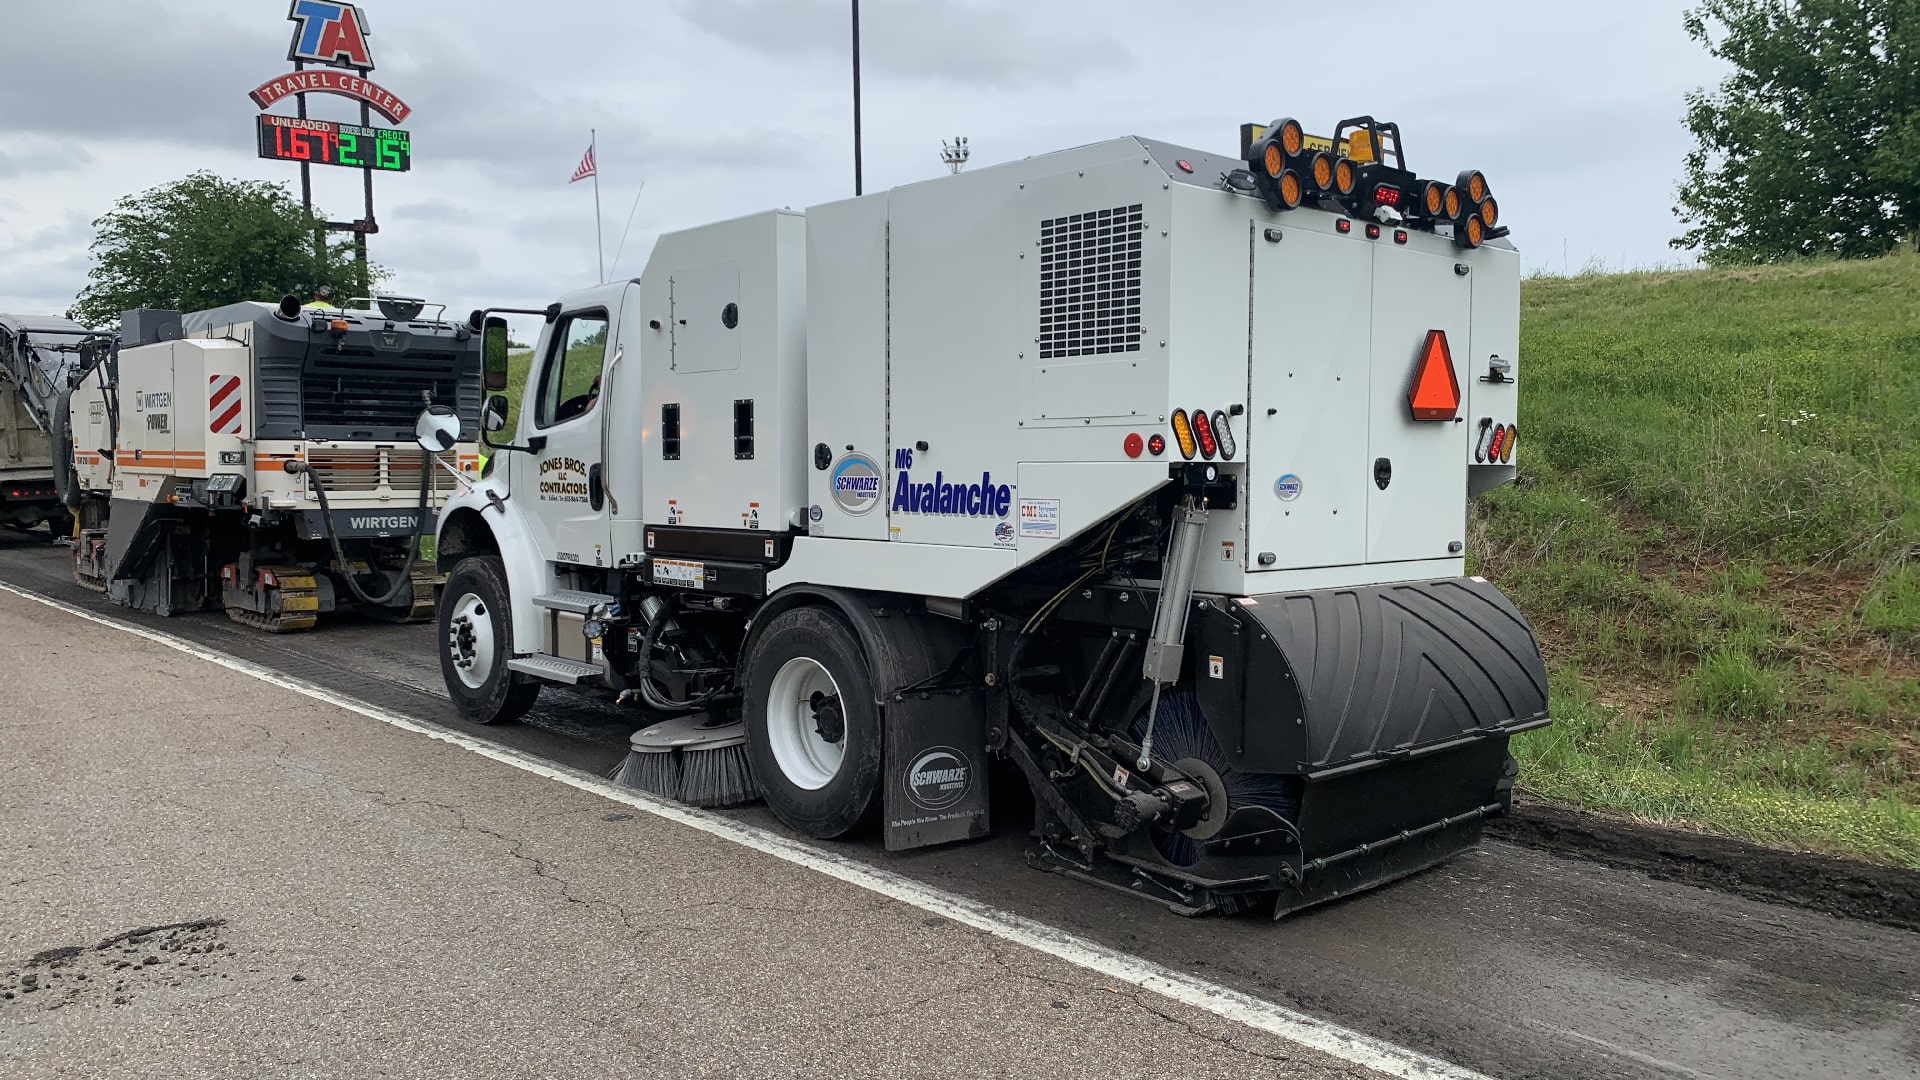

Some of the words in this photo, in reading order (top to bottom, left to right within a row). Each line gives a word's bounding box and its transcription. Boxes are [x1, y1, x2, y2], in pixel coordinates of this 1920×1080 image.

[295, 1, 369, 63] TA
[262, 73, 331, 100] TRAVEL
[339, 76, 404, 117] CENTER
[271, 116, 331, 132] UNLEADED
[377, 130, 408, 141] CREDIT
[145, 391, 172, 408] WIRTGEN
[540, 457, 562, 476] JONES
[895, 448, 913, 469] M6
[558, 472, 567, 480] LLC
[837, 477, 878, 491] SCHWARZE
[540, 482, 587, 495] CONTRACTORS
[892, 471, 1012, 517] Avalanche
[1021, 505, 1037, 517] CMI
[350, 516, 419, 529] WIRTGEN
[913, 767, 966, 787] SCHWARZE
